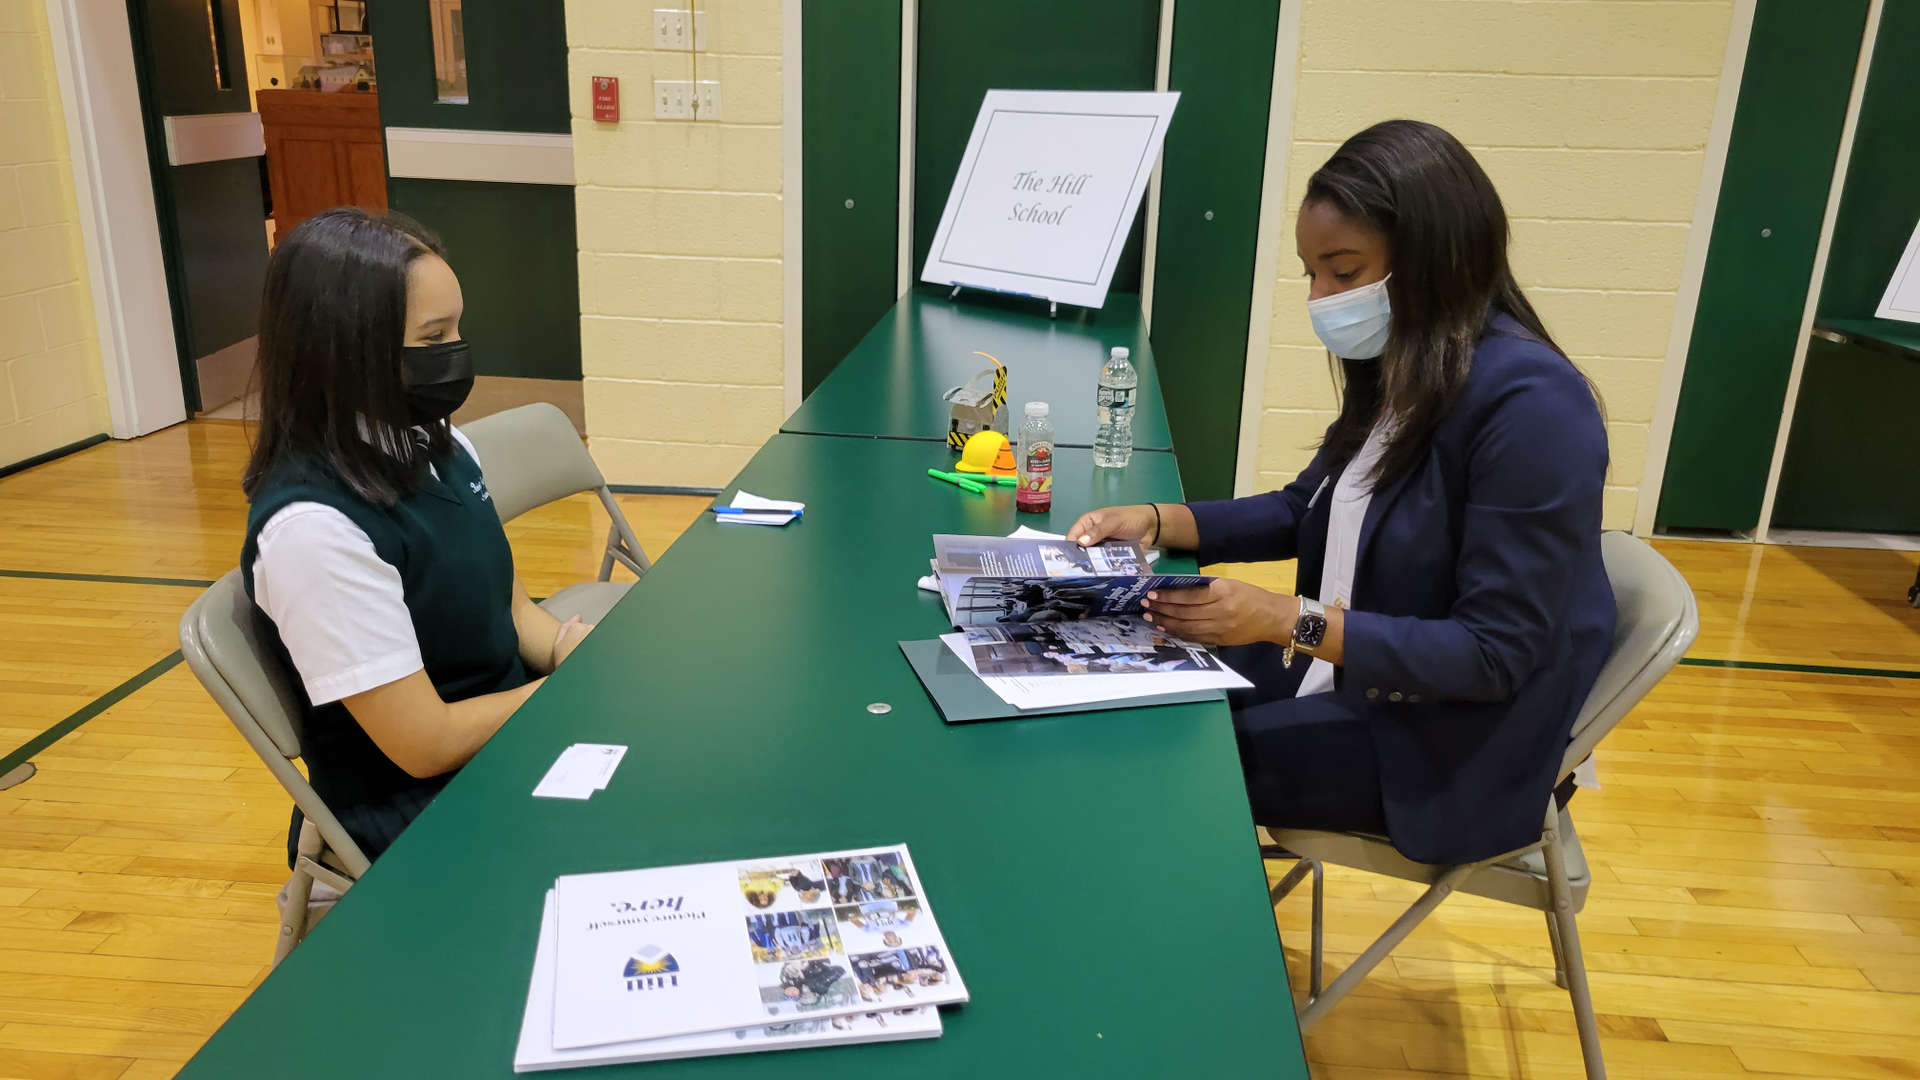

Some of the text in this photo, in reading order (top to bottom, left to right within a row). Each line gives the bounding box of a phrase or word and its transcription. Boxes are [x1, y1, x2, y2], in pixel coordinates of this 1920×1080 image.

[1012, 170, 1093, 195] The Hill
[1008, 202, 1072, 226] School
[626, 975, 678, 992] Hill
